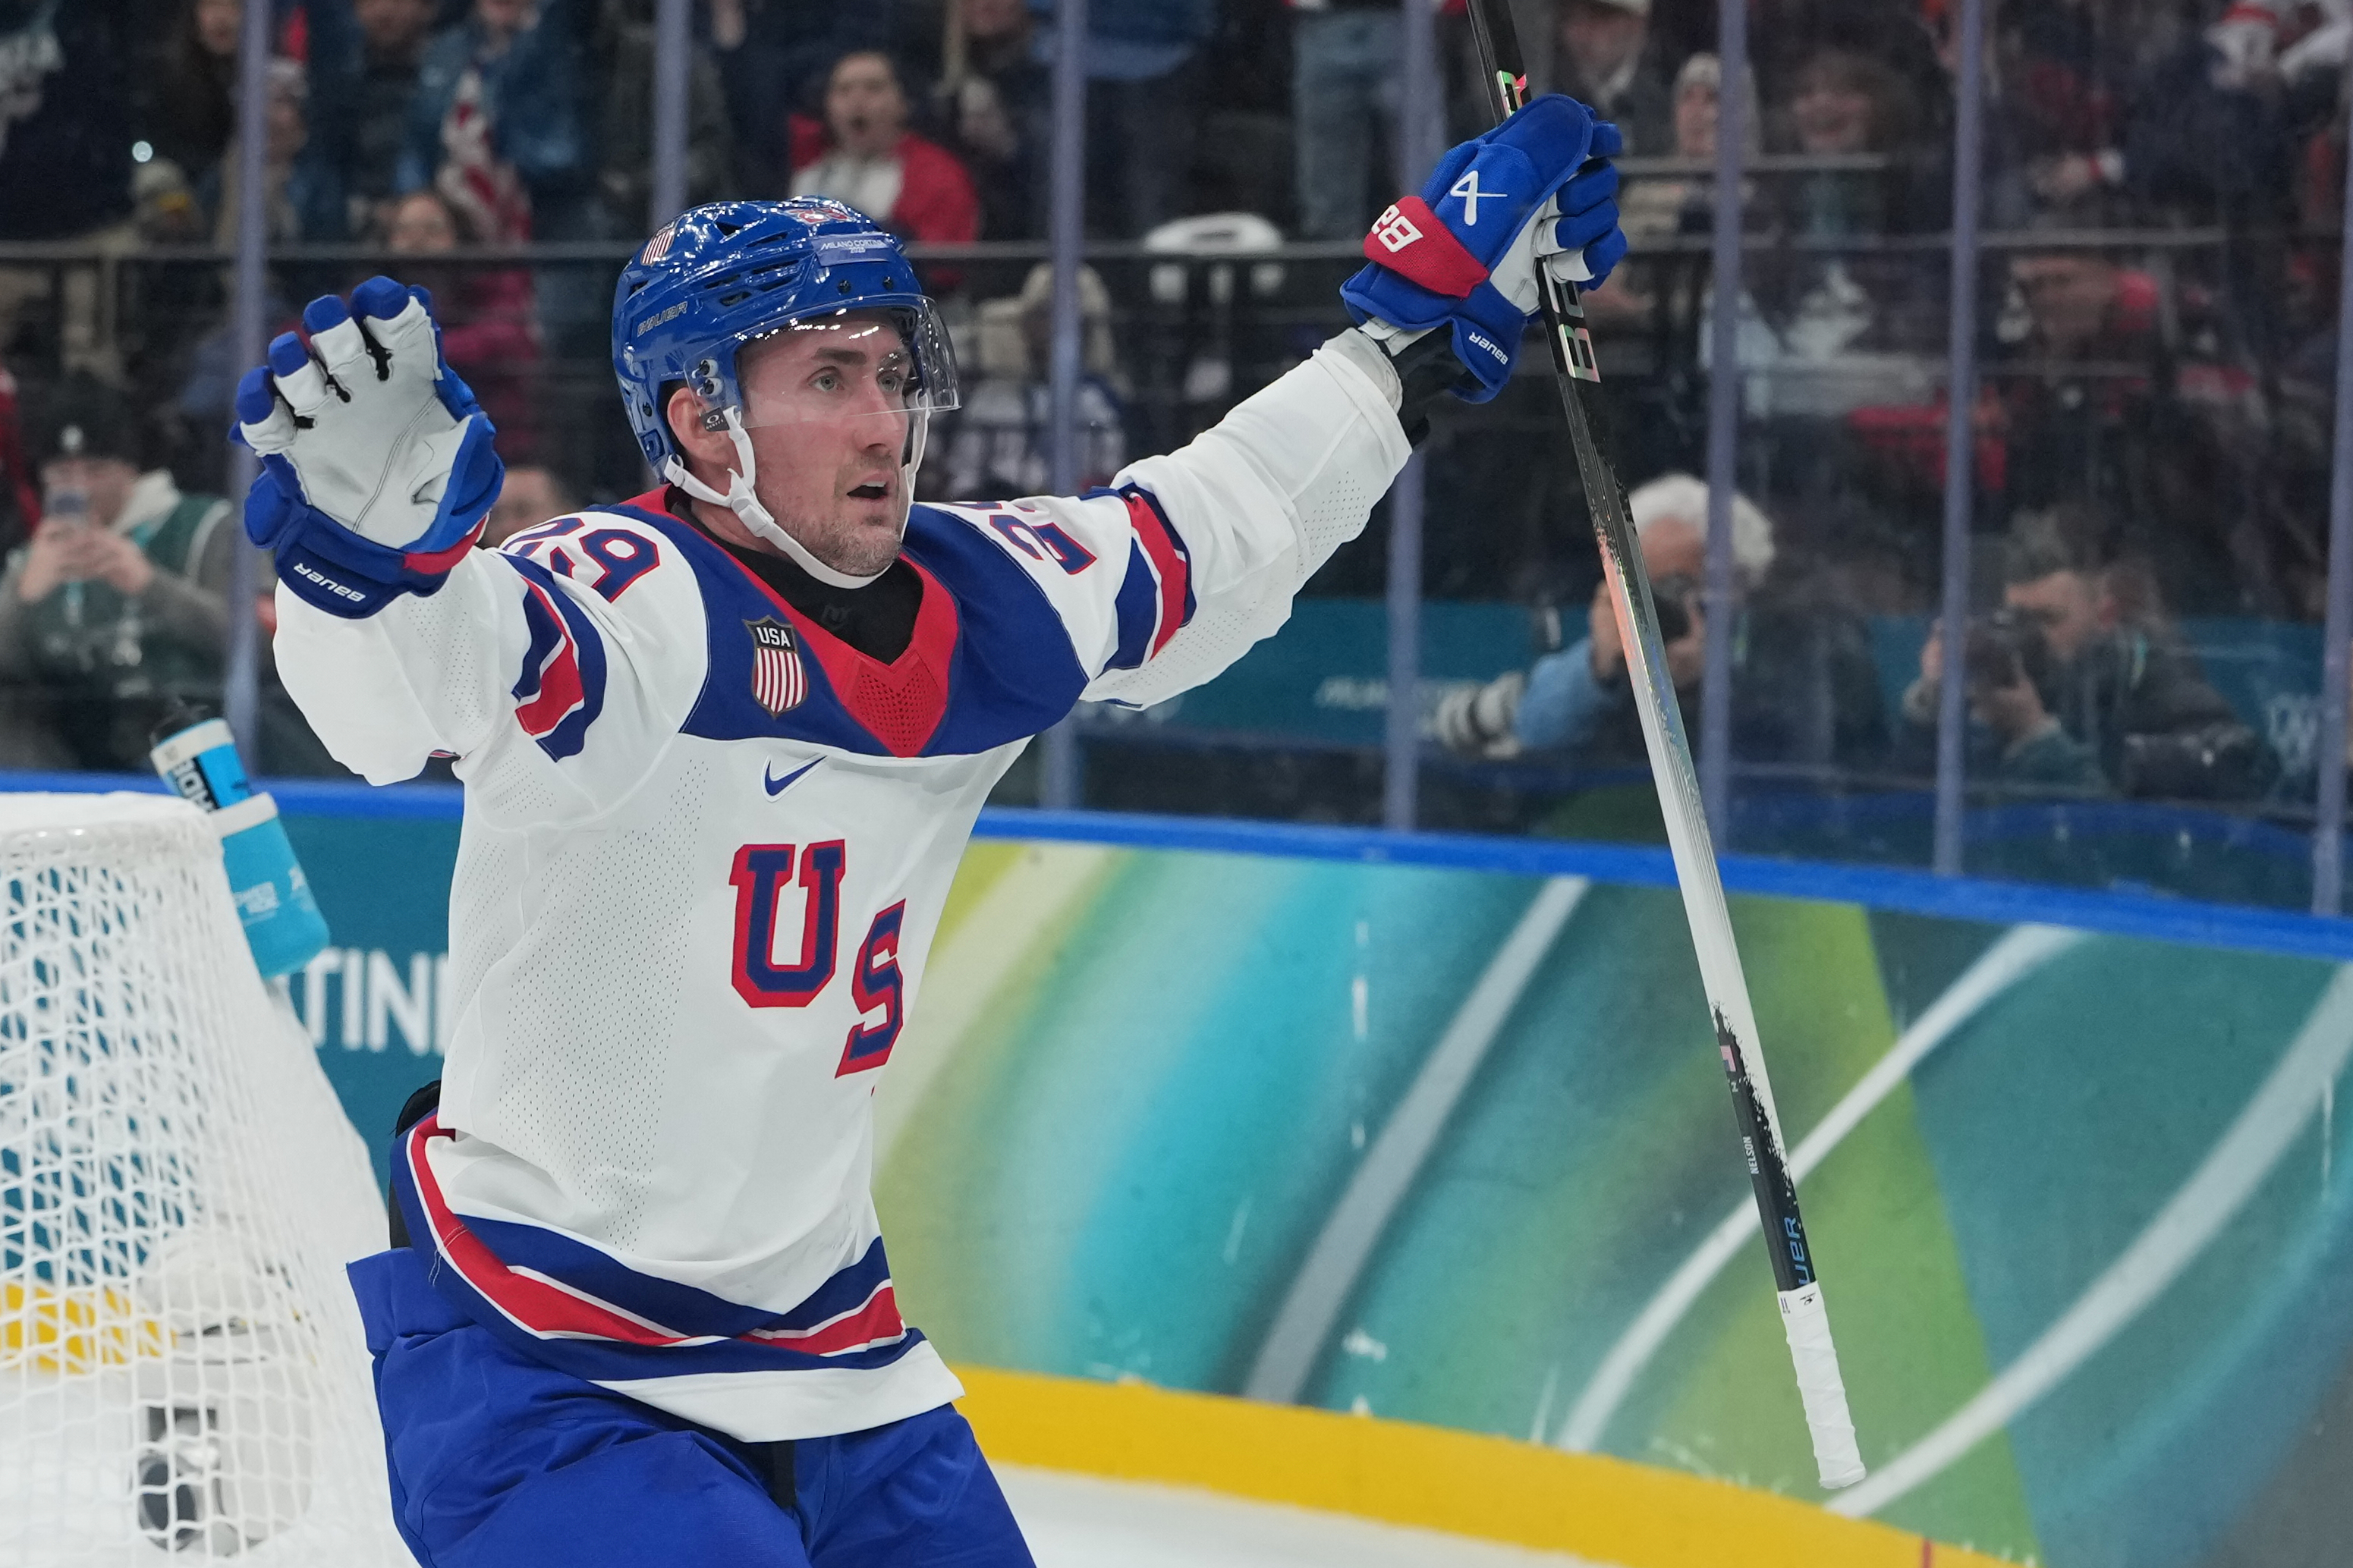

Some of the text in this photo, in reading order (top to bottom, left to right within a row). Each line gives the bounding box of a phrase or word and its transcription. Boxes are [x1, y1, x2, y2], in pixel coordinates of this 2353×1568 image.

[819, 240, 853, 252] MILANO
[757, 627, 791, 648] USA
[728, 839, 907, 1092] US
[1743, 1136, 1760, 1175] NELSON
